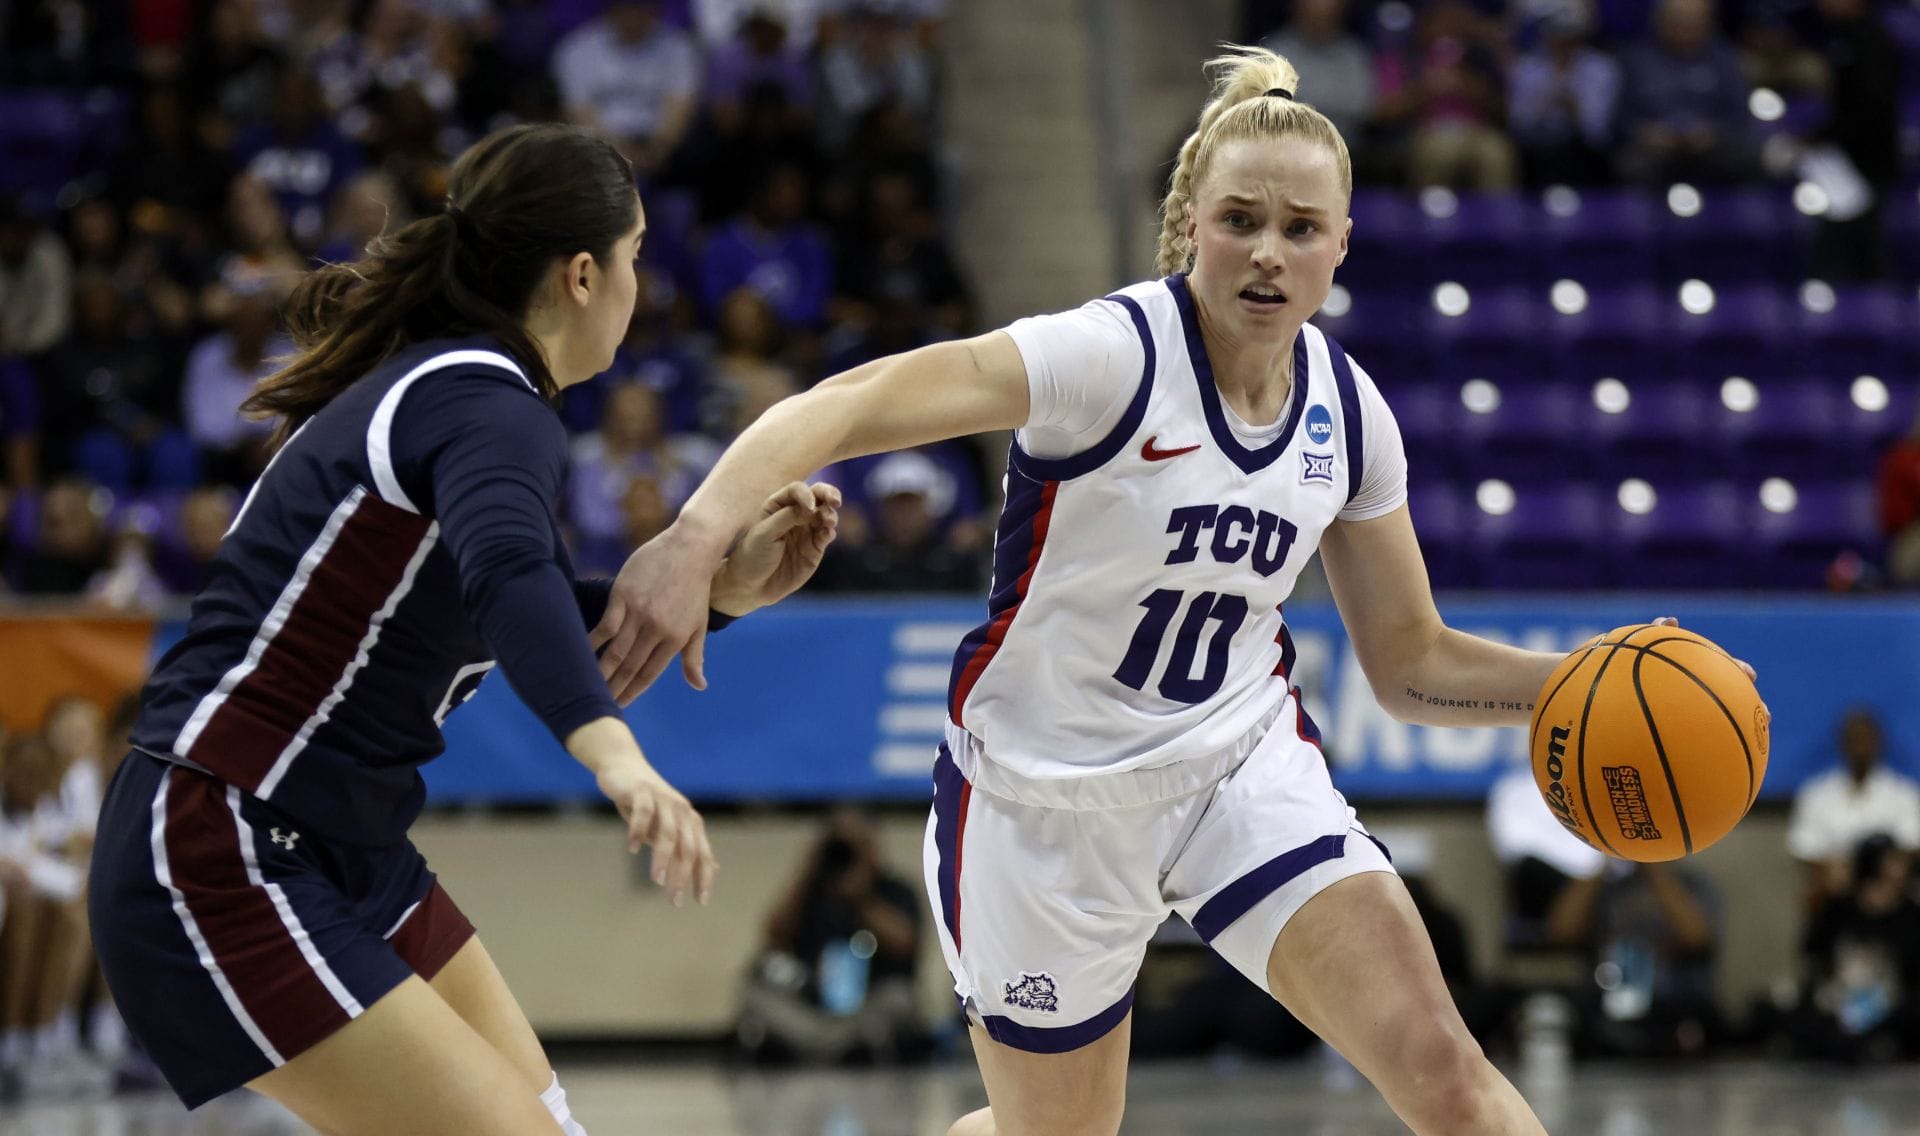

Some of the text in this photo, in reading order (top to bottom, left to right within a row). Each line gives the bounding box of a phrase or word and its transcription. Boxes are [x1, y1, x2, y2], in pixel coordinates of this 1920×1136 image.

[1310, 423, 1332, 434] NCAA
[1164, 504, 1298, 578] TCU
[1112, 588, 1249, 705] 10
[1406, 687, 1424, 702] THE
[1426, 697, 1479, 709] JOURNEY
[1484, 701, 1496, 710] IS
[1500, 702, 1522, 711] THE
[1565, 785, 1576, 807] NXT
[1610, 790, 1635, 829] MARCH
[1619, 767, 1648, 823] MADNESS
